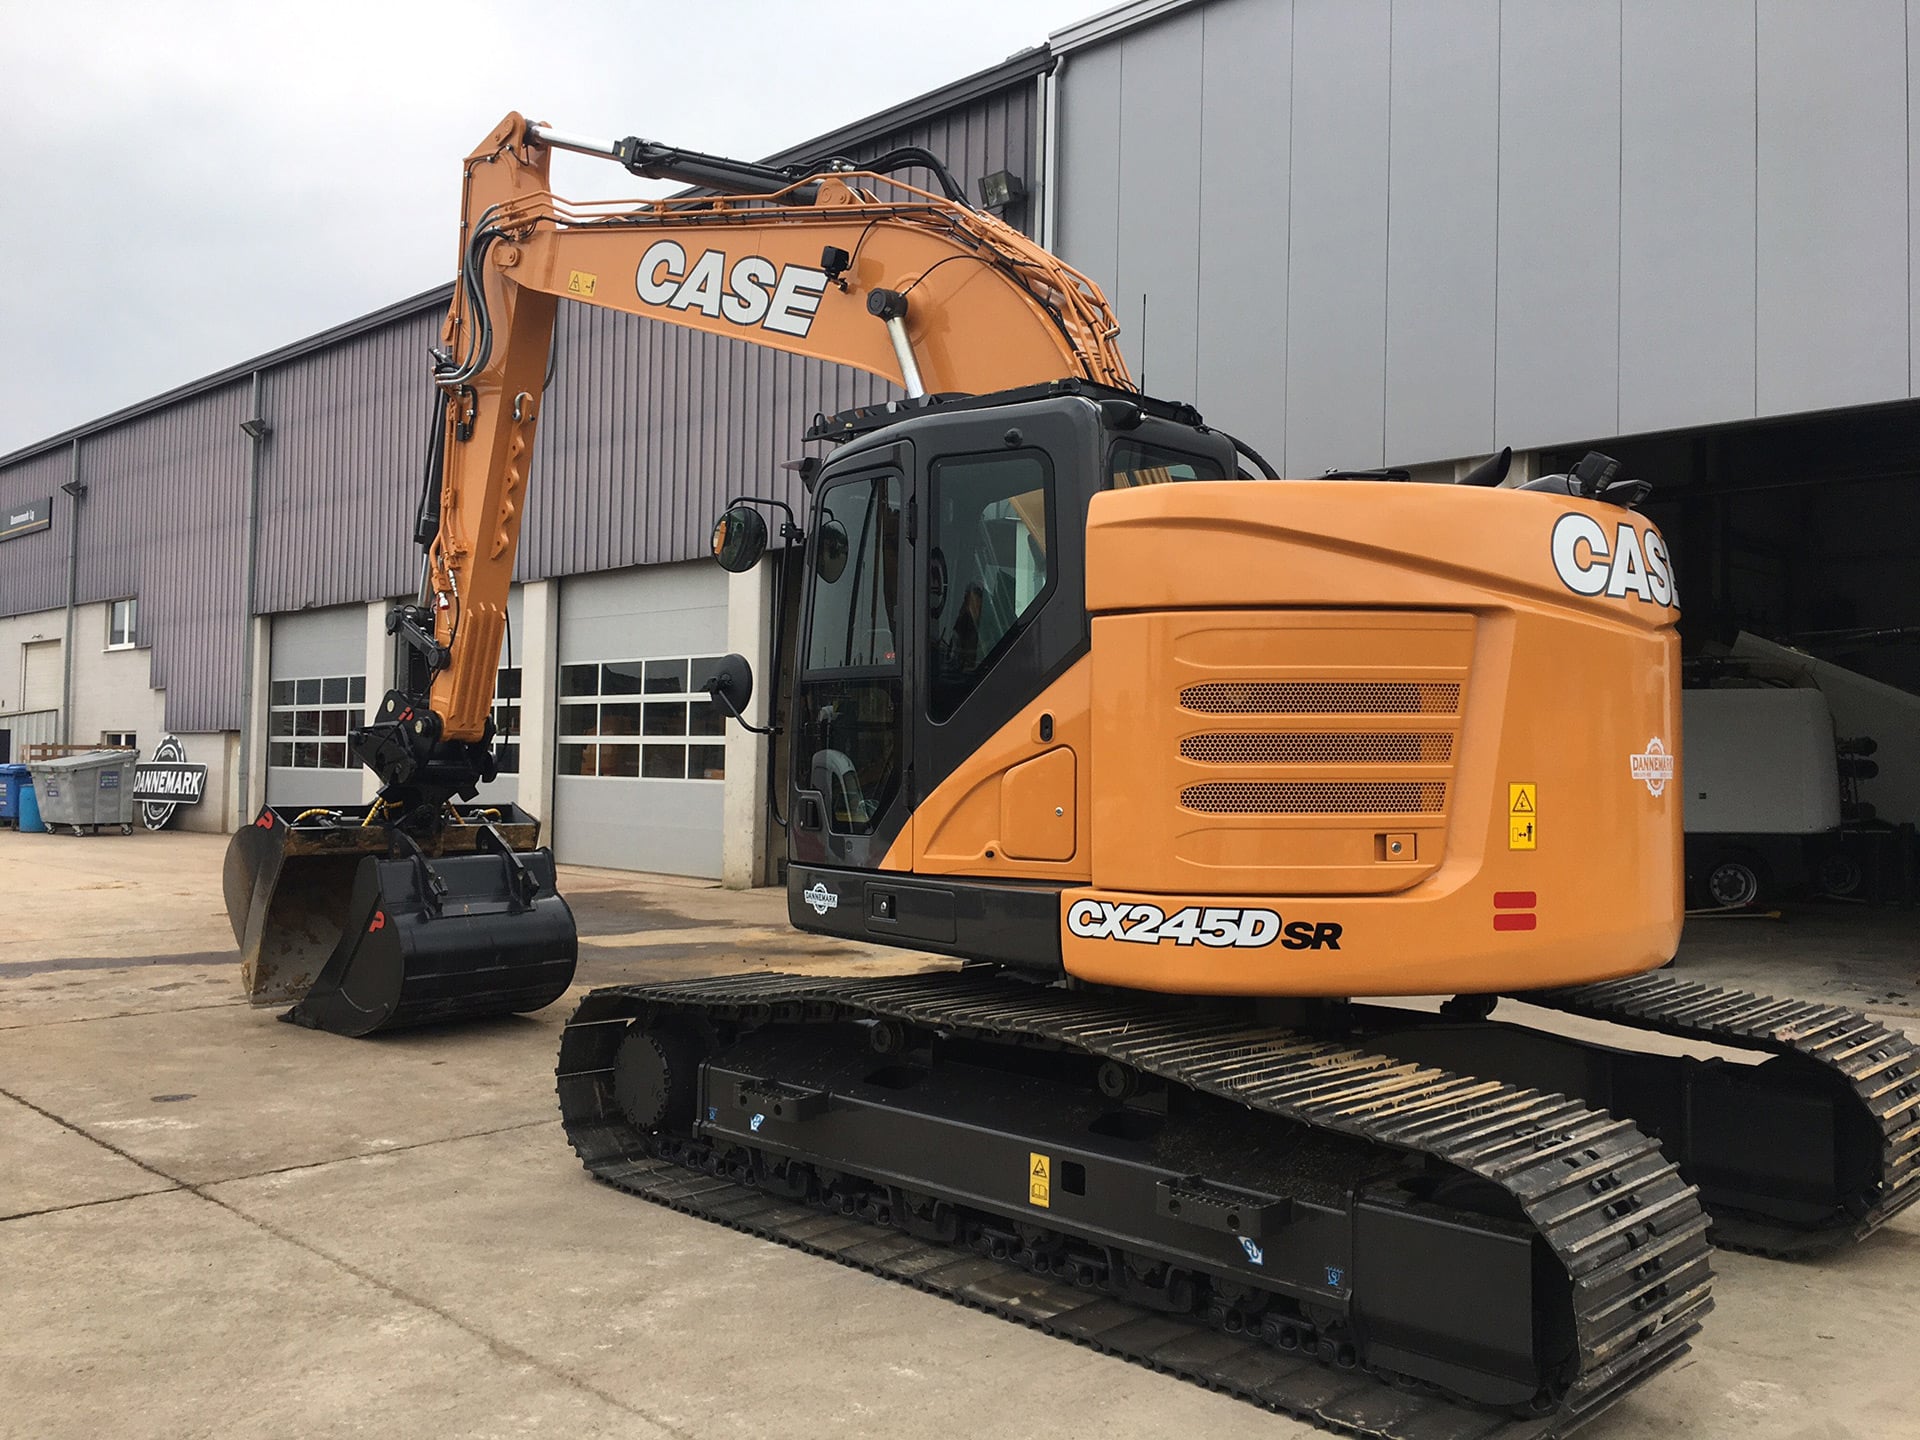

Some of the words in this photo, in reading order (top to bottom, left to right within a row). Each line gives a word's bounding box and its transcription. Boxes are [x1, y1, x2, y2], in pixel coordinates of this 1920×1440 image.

[636, 240, 829, 338] CASE
[133, 770, 203, 795] DANNEMARK
[1067, 898, 1282, 949] CX245D
[1281, 922, 1343, 950] SR
